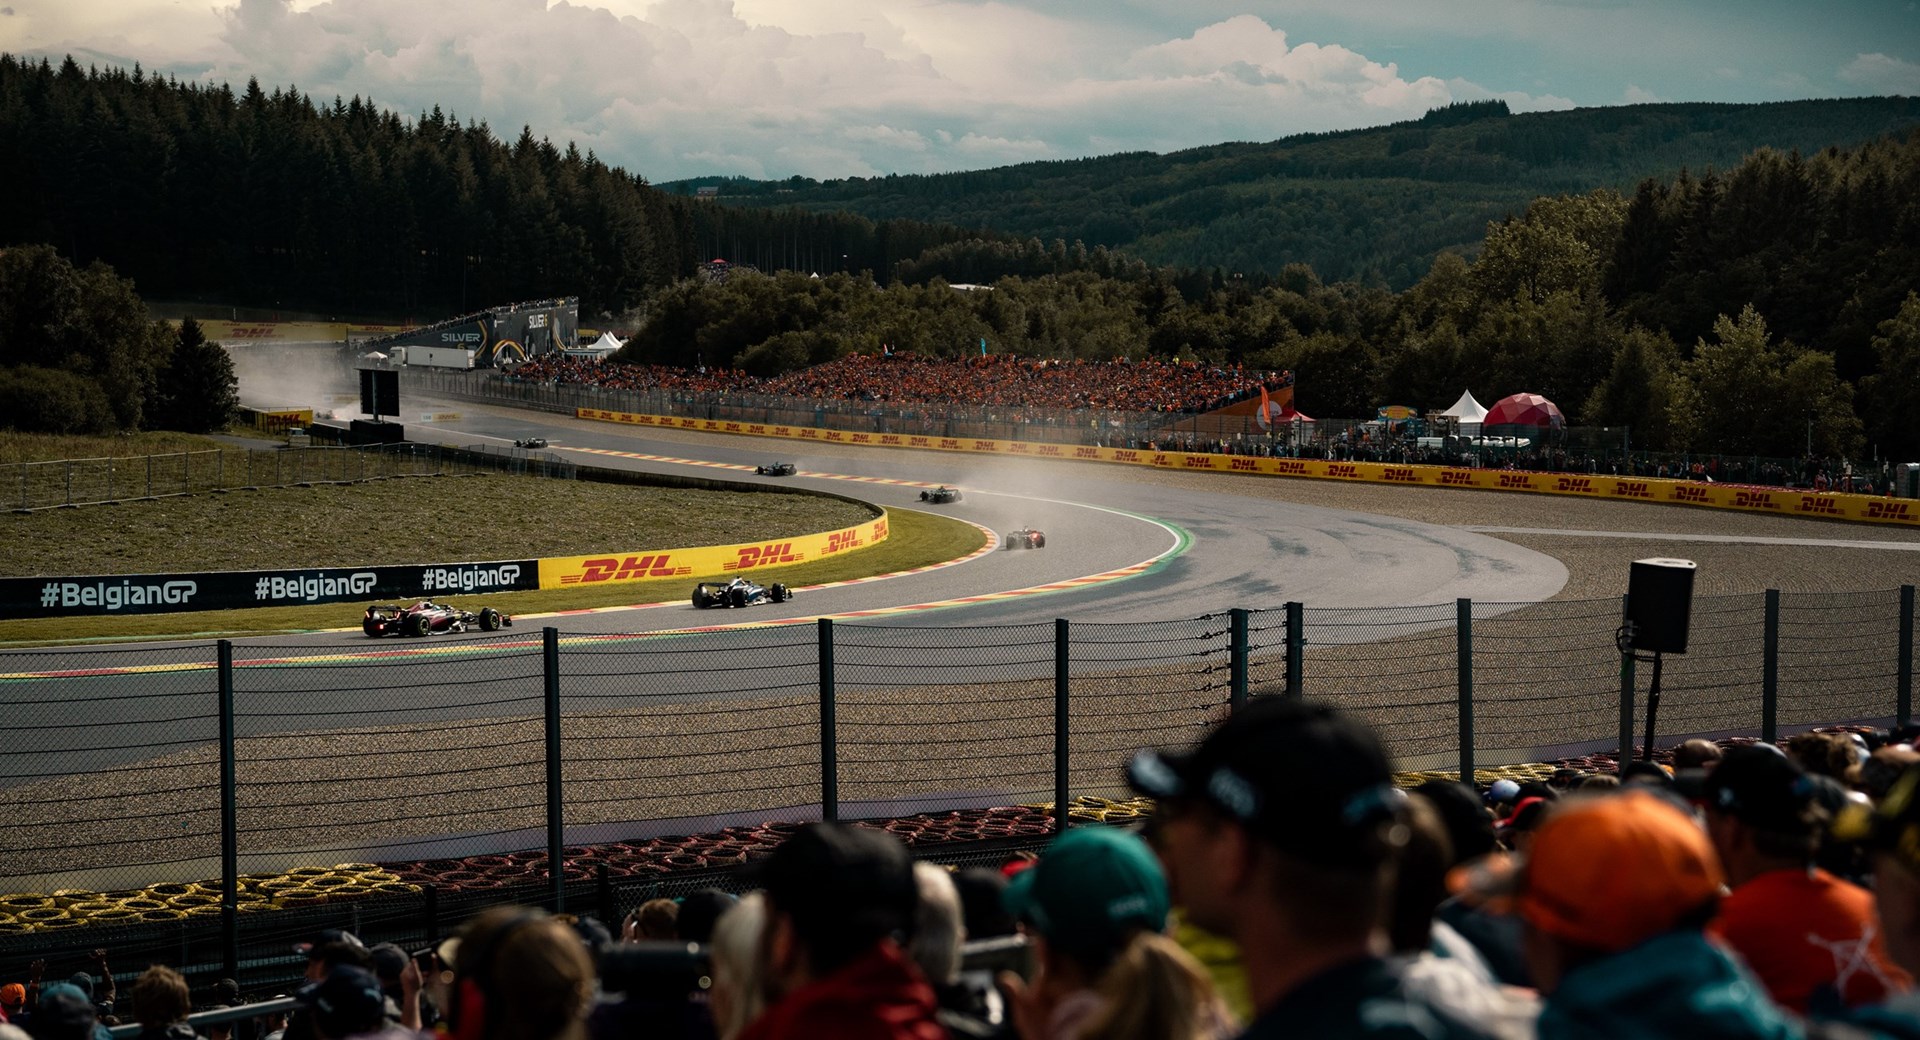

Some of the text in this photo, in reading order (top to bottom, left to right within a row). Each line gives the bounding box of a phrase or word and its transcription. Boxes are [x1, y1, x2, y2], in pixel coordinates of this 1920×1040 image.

[529, 314, 544, 329] SILVER
[231, 328, 275, 338] DHL
[441, 333, 480, 342] SILVER
[881, 435, 900, 445] DHL
[911, 437, 929, 447] DHL
[941, 439, 960, 449] DHL
[975, 441, 996, 451] DHL
[1039, 445, 1061, 456] DHL
[1076, 447, 1098, 459] DHL
[1115, 450, 1138, 462] DHL
[1186, 456, 1212, 468] DHL
[1231, 458, 1258, 471] DHL
[1279, 462, 1307, 474] DHL
[1328, 465, 1358, 478] DHL
[1384, 468, 1417, 482] DHL
[1441, 471, 1474, 485] DHL
[1499, 474, 1532, 489] DHL
[1558, 478, 1592, 493] DHL
[1616, 482, 1649, 497] DHL
[1675, 486, 1709, 502] DHL
[1735, 492, 1774, 508] DHL
[1801, 496, 1838, 514] DHL
[1867, 502, 1910, 520] DHL
[873, 519, 887, 542] DHL
[828, 529, 859, 553] DHL
[737, 543, 795, 569] DHL
[580, 555, 676, 582] DHL
[422, 564, 520, 591] #BelgianGP
[254, 572, 377, 601] #BelgianGP
[40, 579, 197, 610] #BelgianGP
